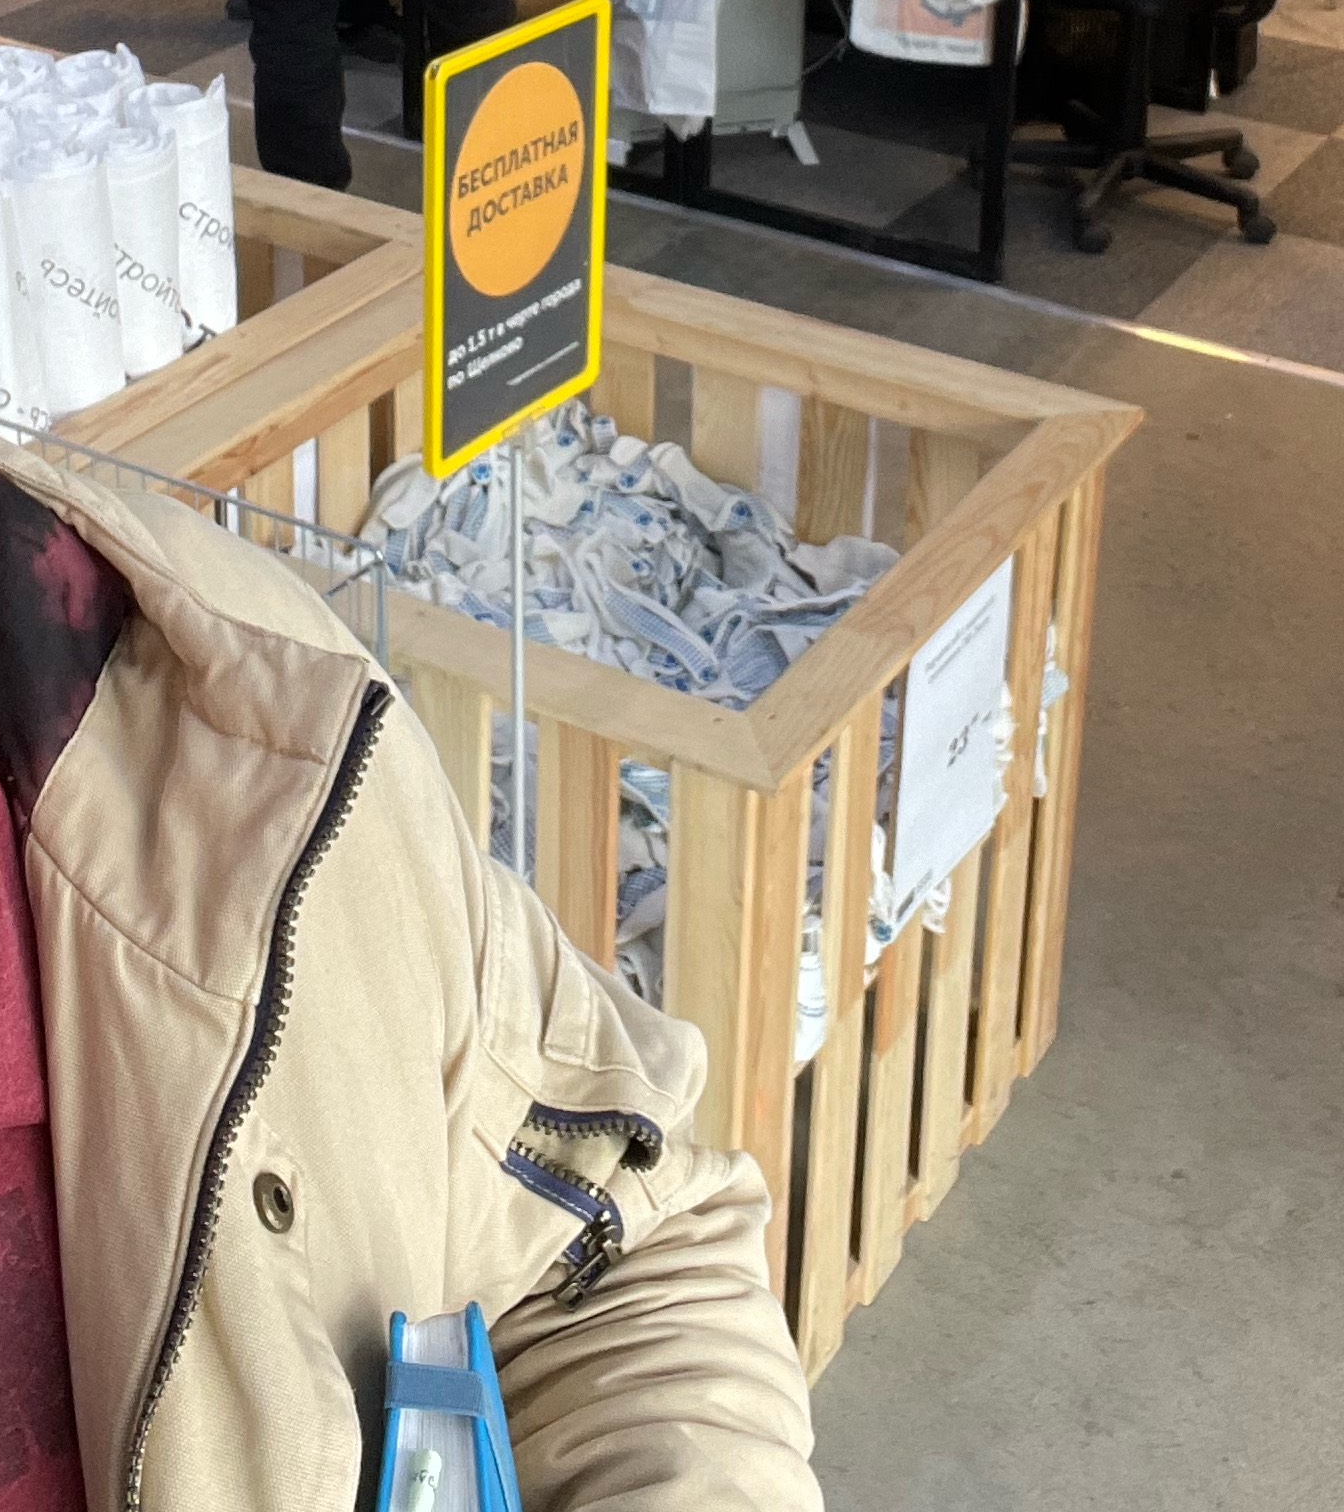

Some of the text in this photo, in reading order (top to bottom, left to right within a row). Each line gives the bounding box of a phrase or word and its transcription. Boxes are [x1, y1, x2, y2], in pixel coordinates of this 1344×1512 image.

[457, 120, 578, 199] БЕСПЛАТНАЯ
[178, 201, 233, 249] стро
[466, 163, 568, 238] ДОСТАВКА
